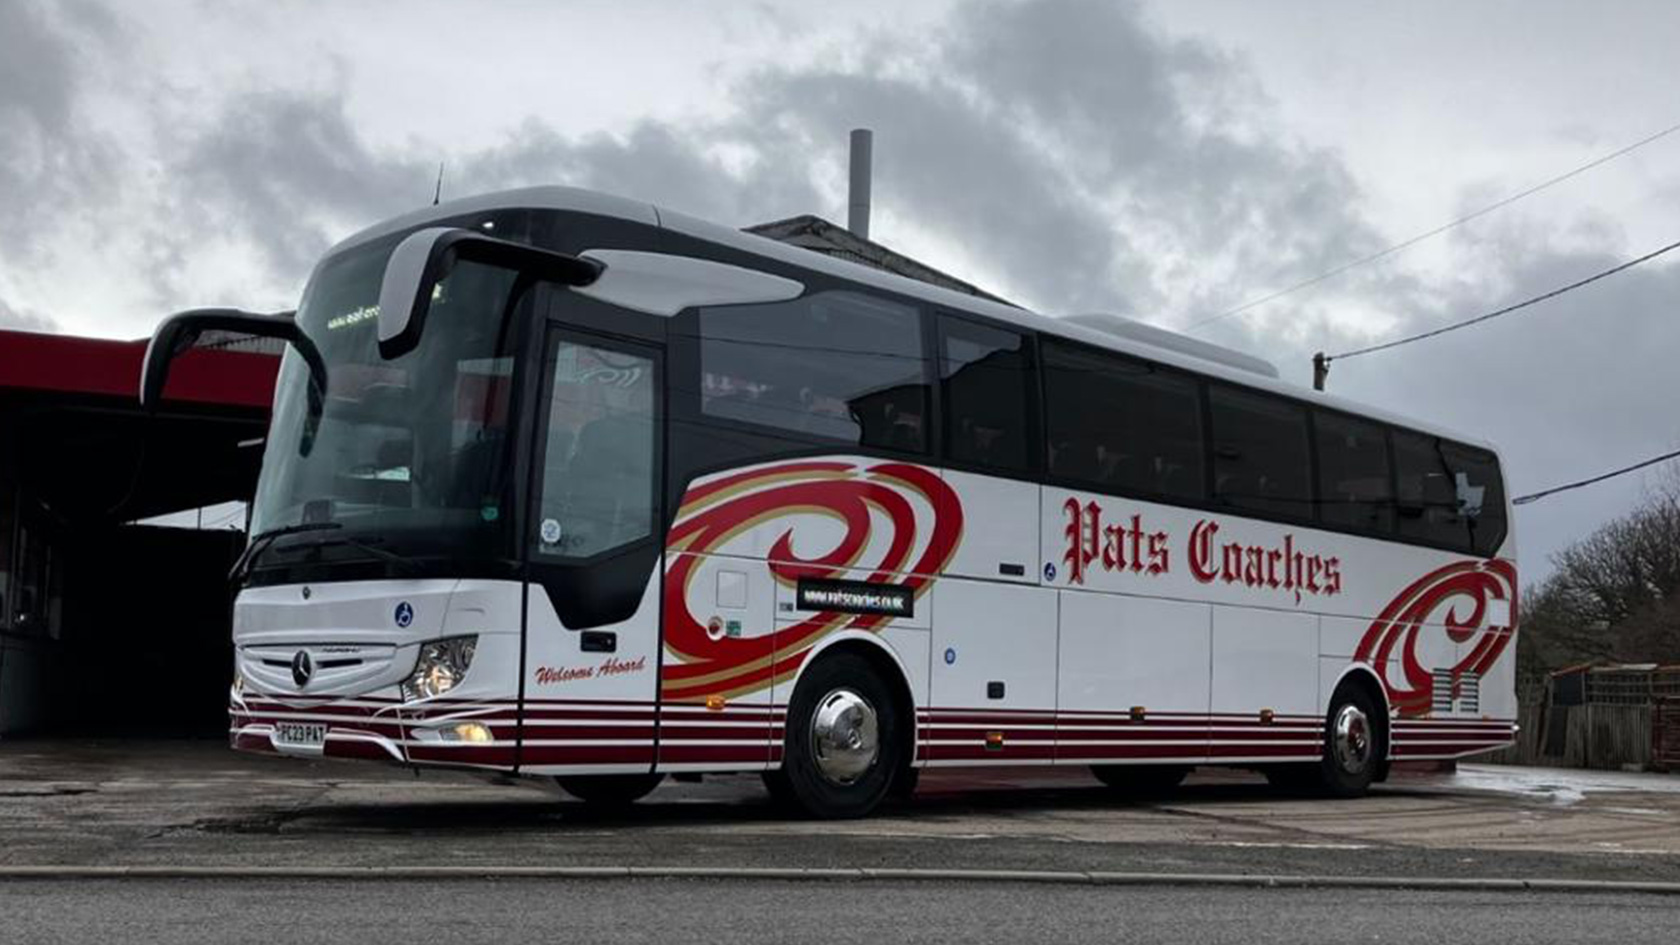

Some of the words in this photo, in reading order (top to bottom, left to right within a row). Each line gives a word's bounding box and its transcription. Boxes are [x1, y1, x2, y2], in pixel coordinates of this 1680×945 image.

[1063, 497, 1169, 585] Pats
[1187, 519, 1341, 605] Coaches
[535, 666, 593, 685] Welcome
[596, 656, 646, 678] Aboard
[281, 723, 304, 742] PC23
[306, 725, 324, 743] PAT
